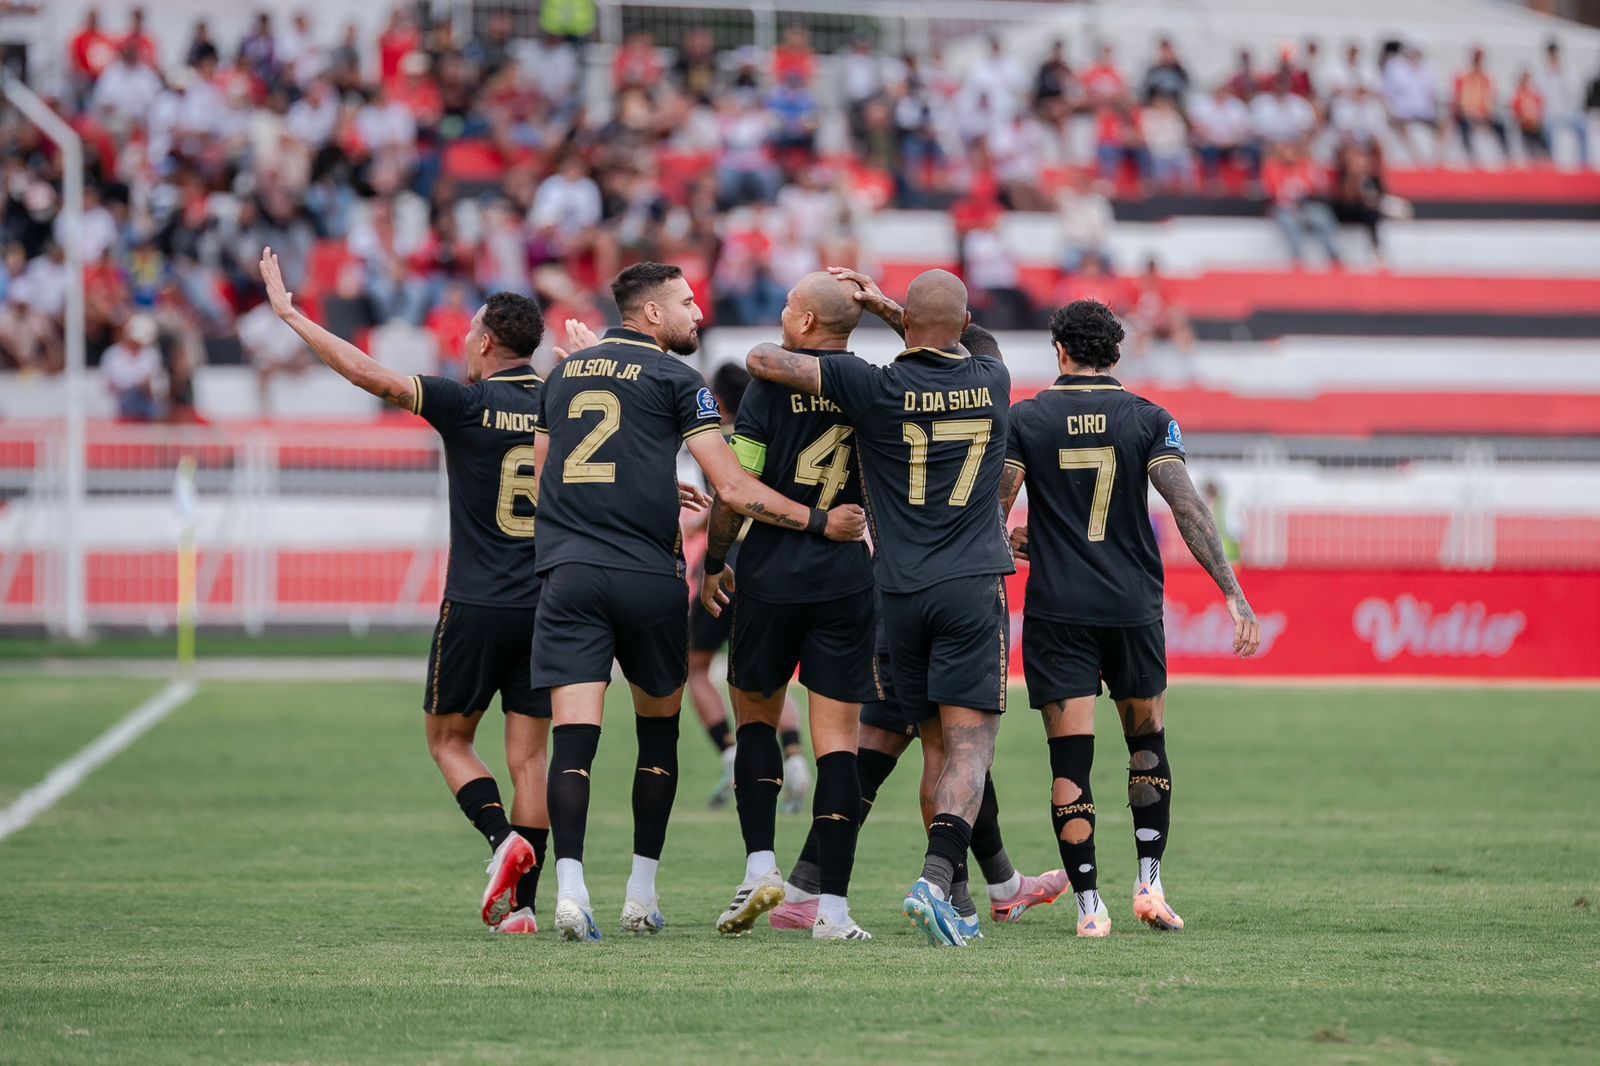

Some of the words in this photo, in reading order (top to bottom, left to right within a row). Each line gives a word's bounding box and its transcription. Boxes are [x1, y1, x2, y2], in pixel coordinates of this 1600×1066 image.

[562, 358, 618, 378] NILSON
[616, 363, 642, 381] JR
[790, 393, 807, 413] G.
[948, 386, 994, 411] SILVA
[482, 408, 491, 428] I.
[495, 410, 539, 433] INOC
[562, 389, 621, 484] 2
[1067, 414, 1107, 435] CIRO
[495, 444, 536, 538] 6
[794, 424, 853, 511] 4
[902, 418, 993, 507] 17
[1058, 446, 1117, 542] 7
[1352, 592, 1527, 662] Vidio
